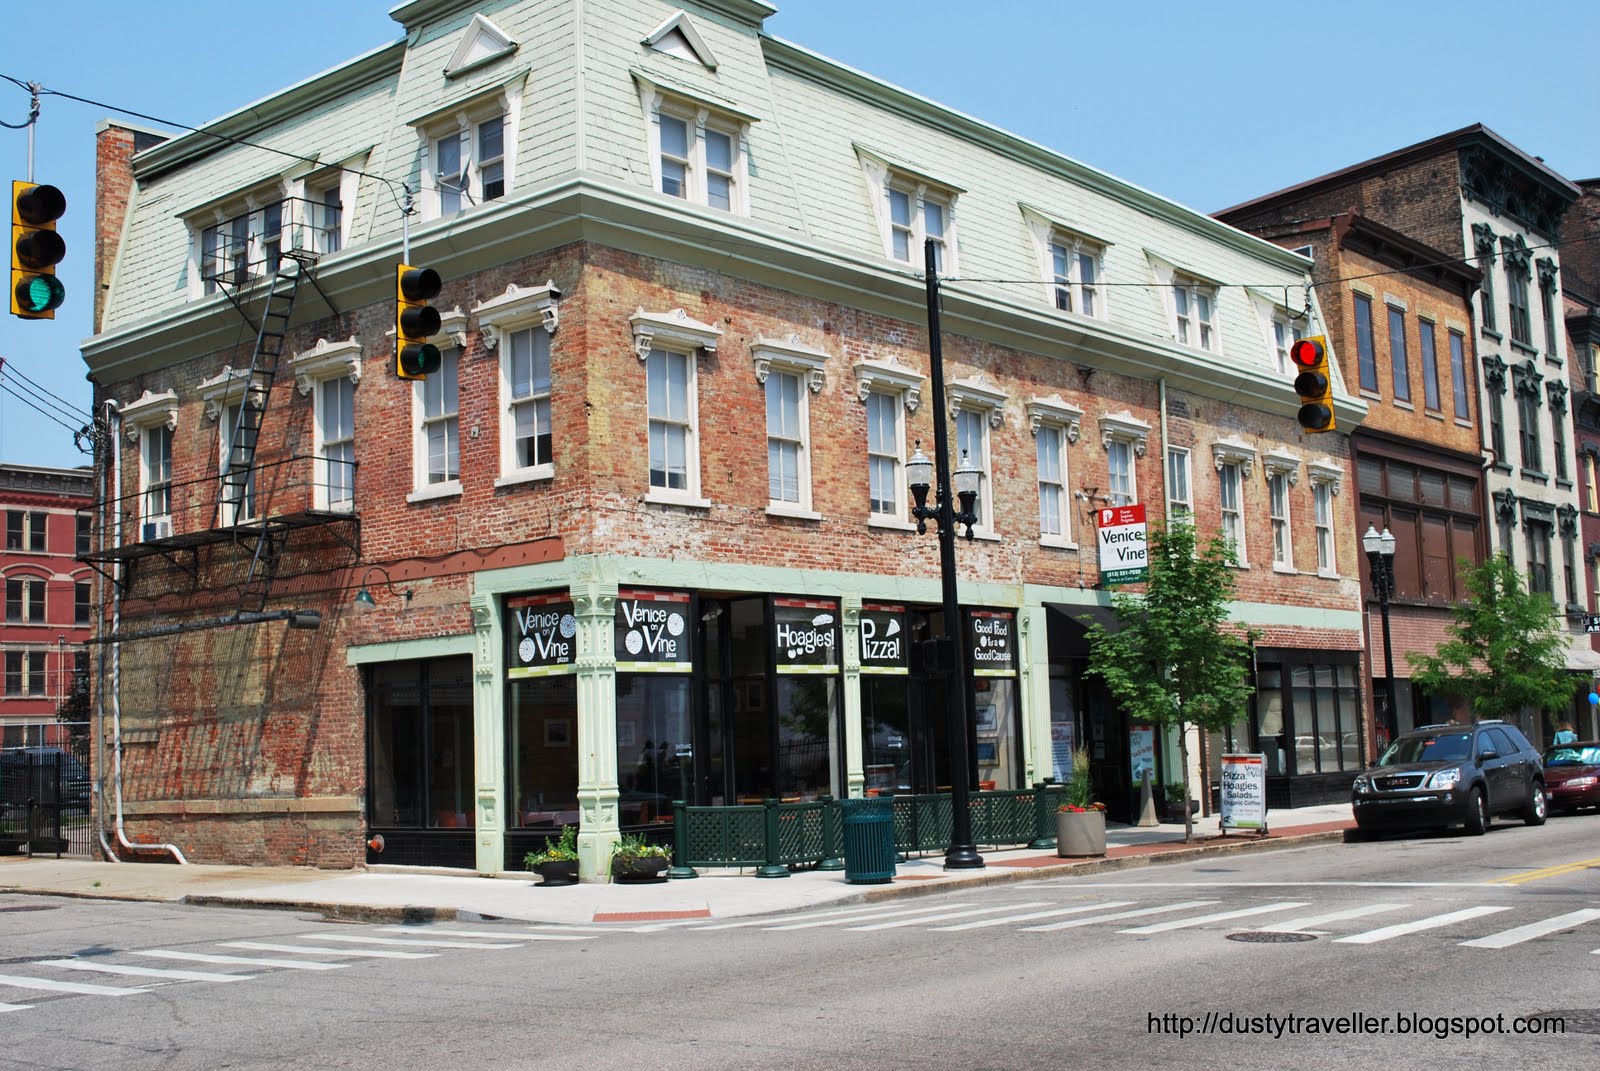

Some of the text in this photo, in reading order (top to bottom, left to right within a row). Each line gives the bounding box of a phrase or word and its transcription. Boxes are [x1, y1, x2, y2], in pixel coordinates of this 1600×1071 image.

[1102, 528, 1142, 544] Venice
[1117, 547, 1145, 561] Vine
[516, 607, 559, 635] Venice
[621, 600, 666, 628] Venice
[1593, 617, 1600, 625] S
[974, 619, 1007, 635] Good Food
[535, 627, 569, 660] Vine
[642, 624, 676, 653] Vine
[777, 624, 834, 654] Hoagies!
[861, 619, 900, 659] Pizza!
[557, 656, 569, 664] pizza
[974, 647, 1011, 661] Good Cause
[1227, 791, 1253, 799] Salads
